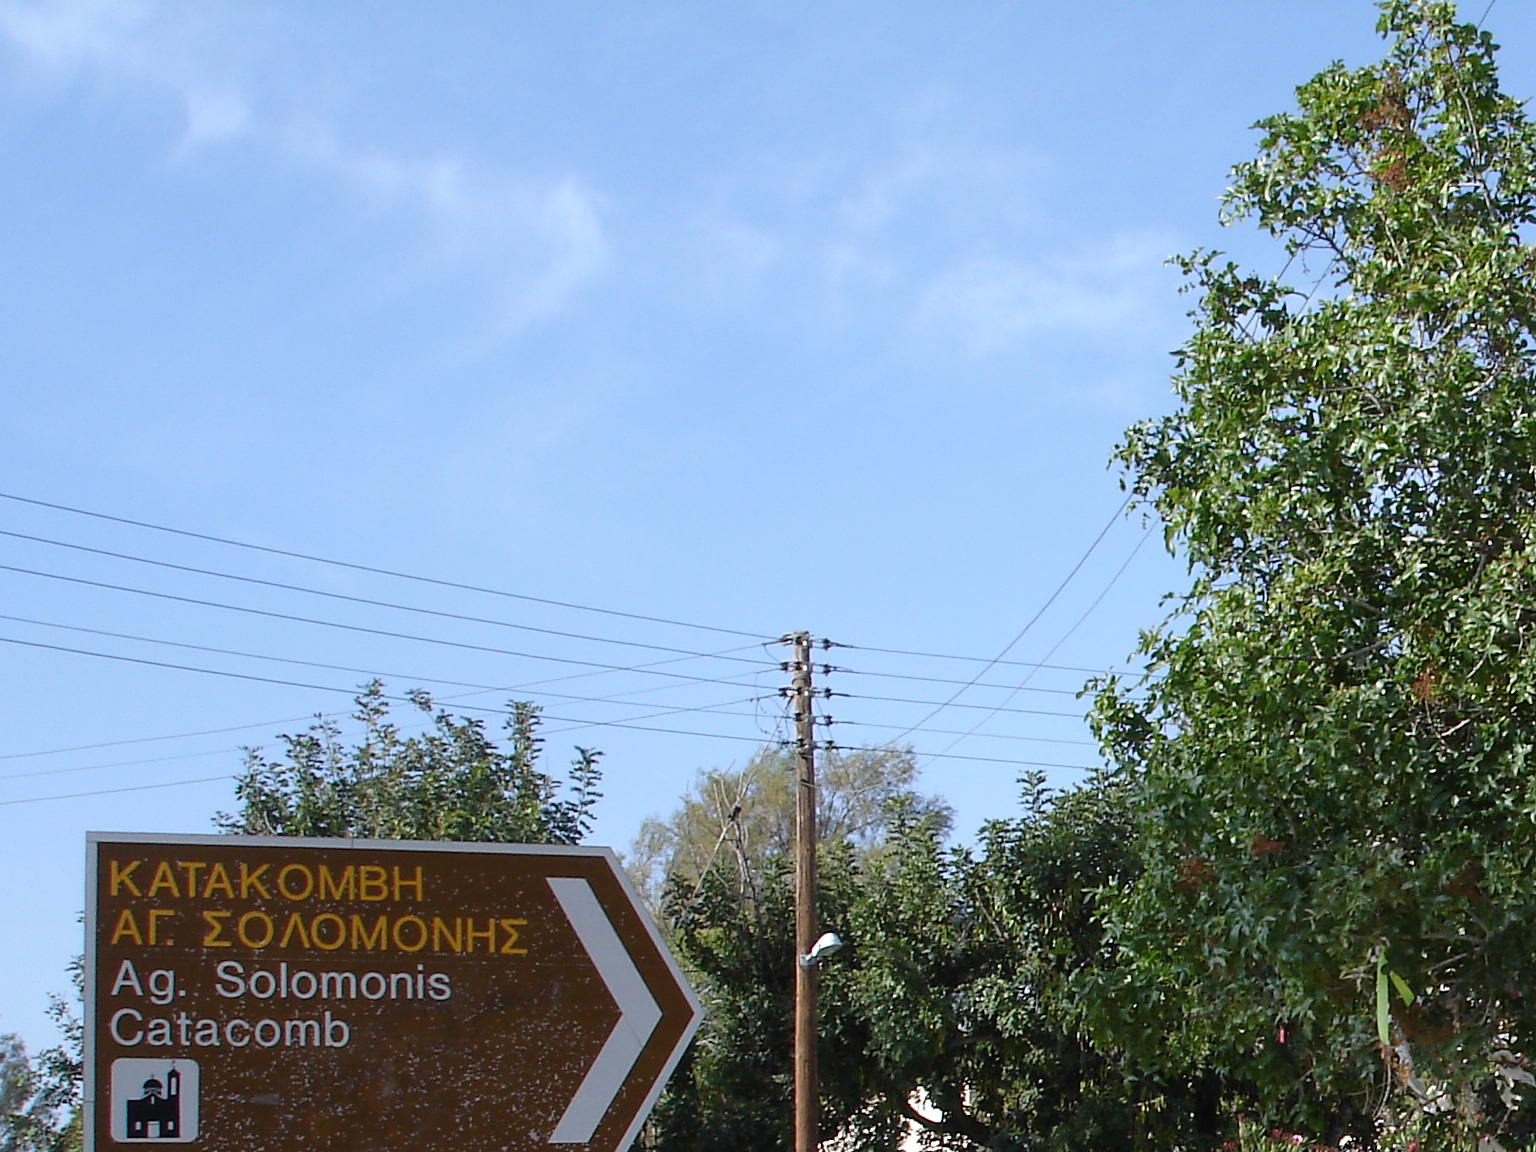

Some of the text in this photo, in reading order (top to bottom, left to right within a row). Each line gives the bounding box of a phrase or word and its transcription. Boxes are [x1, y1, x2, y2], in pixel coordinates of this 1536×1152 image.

[109, 859, 424, 903] ΚΑΤΑΚΟΜΒΗ
[110, 909, 529, 955] ΑΓ. ΣΟΛΟΜΟΝΗΣ
[109, 958, 453, 1004] Ag. Solomonis
[109, 1006, 352, 1049] Catacomb
